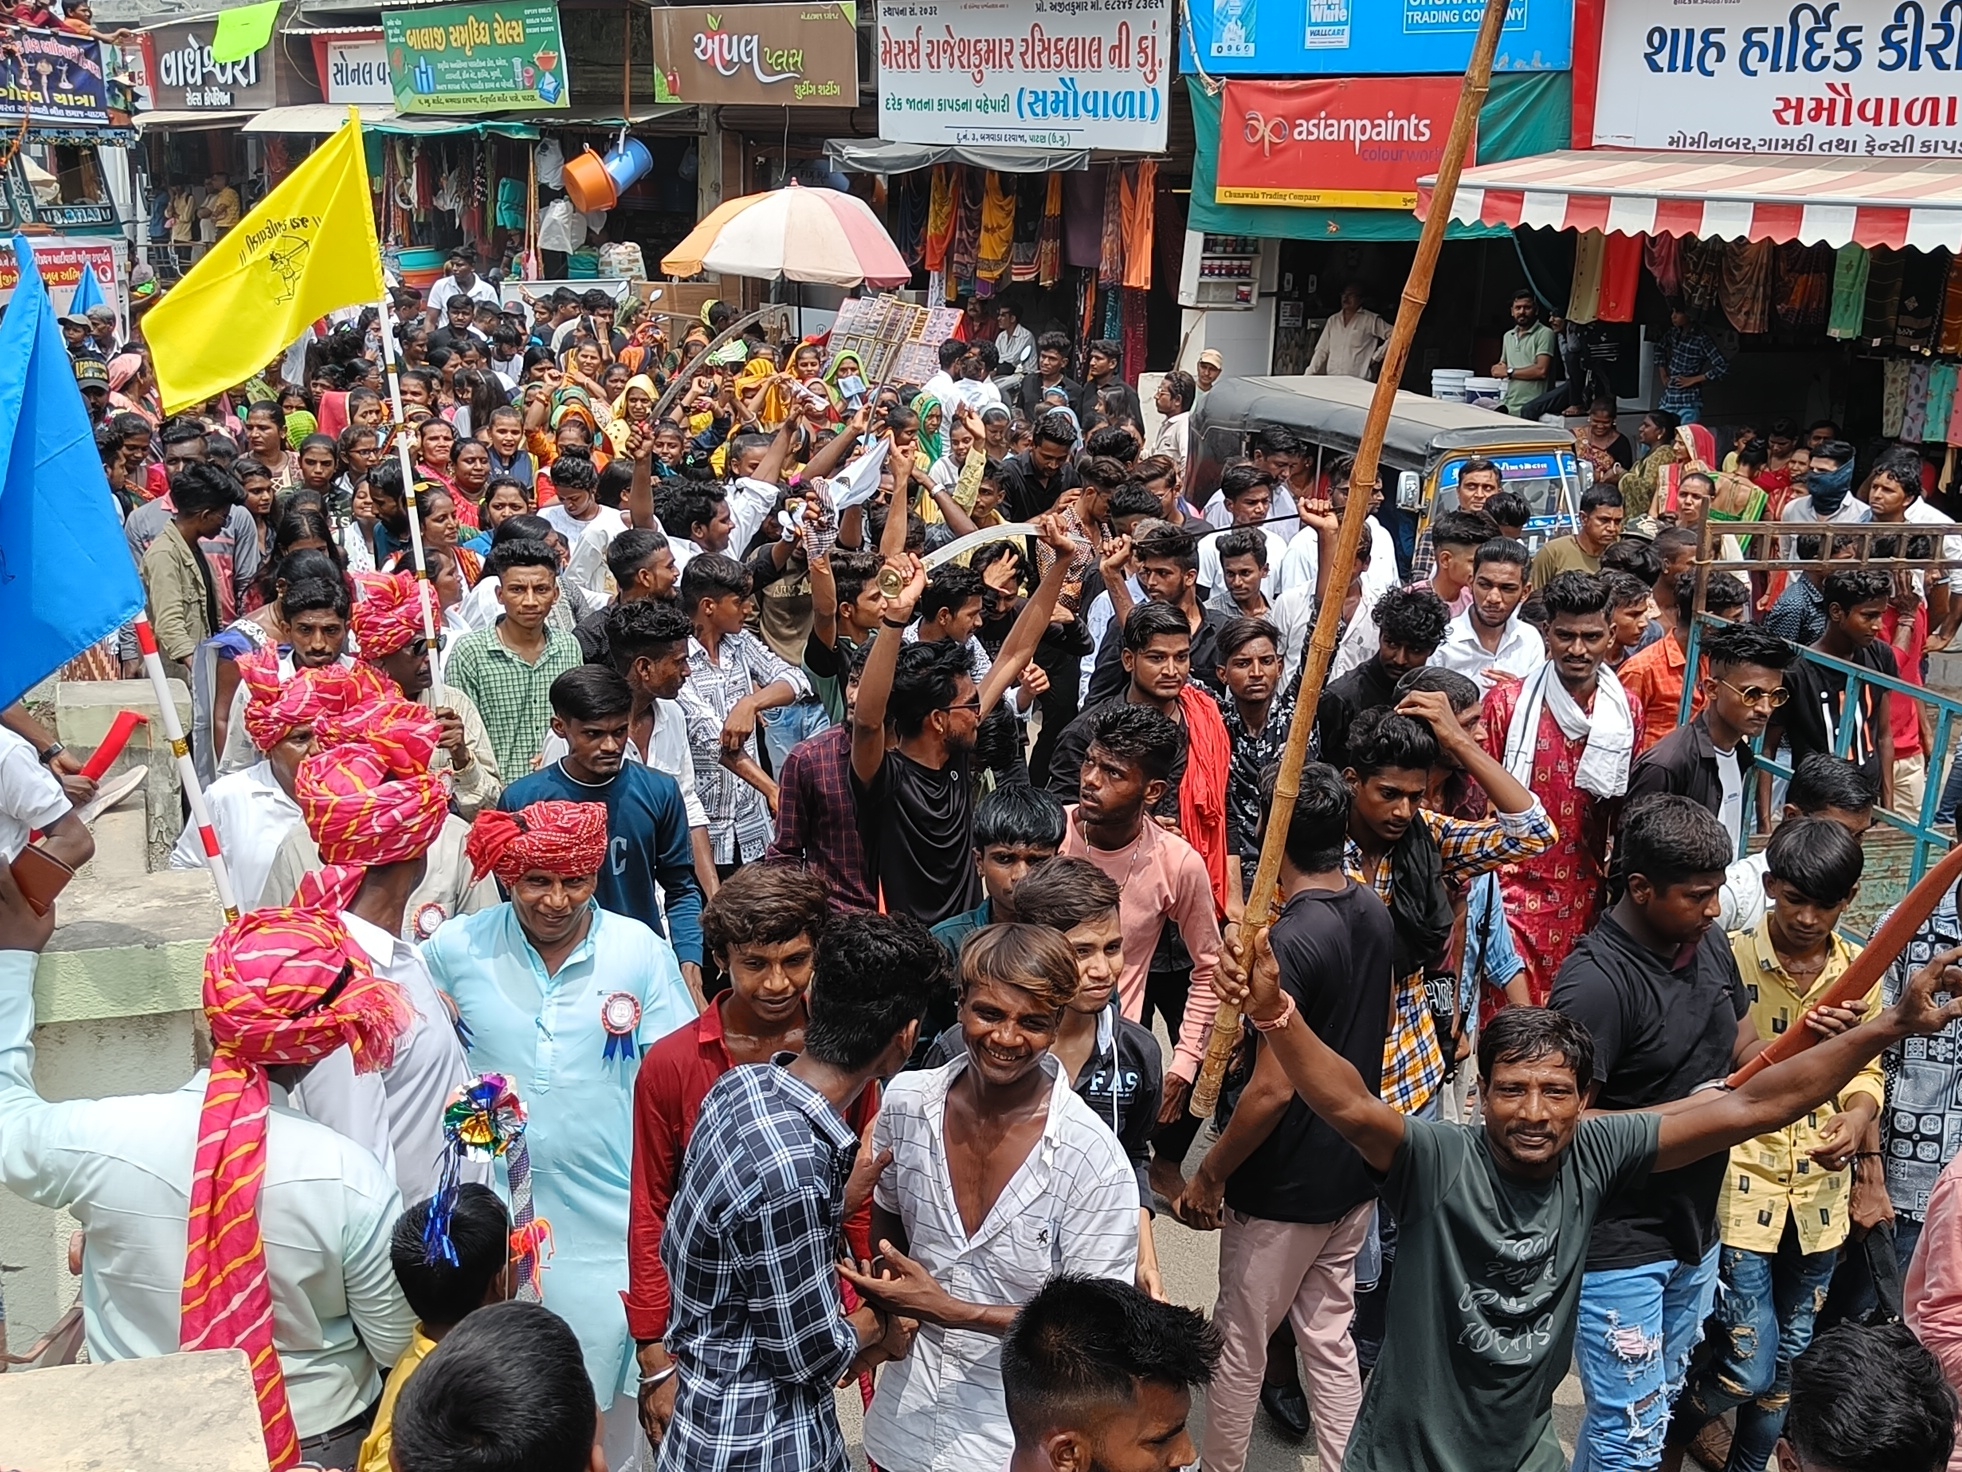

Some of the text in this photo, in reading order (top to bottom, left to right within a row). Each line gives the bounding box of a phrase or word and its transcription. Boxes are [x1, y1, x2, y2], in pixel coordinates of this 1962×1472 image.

[1310, 5, 1348, 23] White
[1406, 8, 1525, 24] TRADING CONY
[406, 26, 446, 52] બાલાજી
[493, 12, 524, 44] સેલ્સ
[1310, 29, 1345, 37] WALLCARE
[1643, 26, 1726, 77] શાહ
[1738, 2, 1863, 77] હાર્દિક
[764, 47, 803, 72] પ્લસ
[881, 26, 922, 70] મેસર્સ
[925, 25, 1014, 84] રાજેશકુમાર
[1018, 23, 1102, 70] રસિકલાલ
[1108, 20, 1131, 70] ની
[333, 51, 373, 86] સોનલ
[885, 93, 903, 111] દરેક
[905, 97, 935, 113] જાતના
[937, 98, 973, 113] કાપડના
[975, 93, 1010, 115] વહેપારી
[1818, 139, 1857, 152] તથા
[1864, 134, 1915, 156] ફેન્સી
[1223, 190, 1321, 202] Chunawala Trading Company
[611, 836, 627, 875] C
